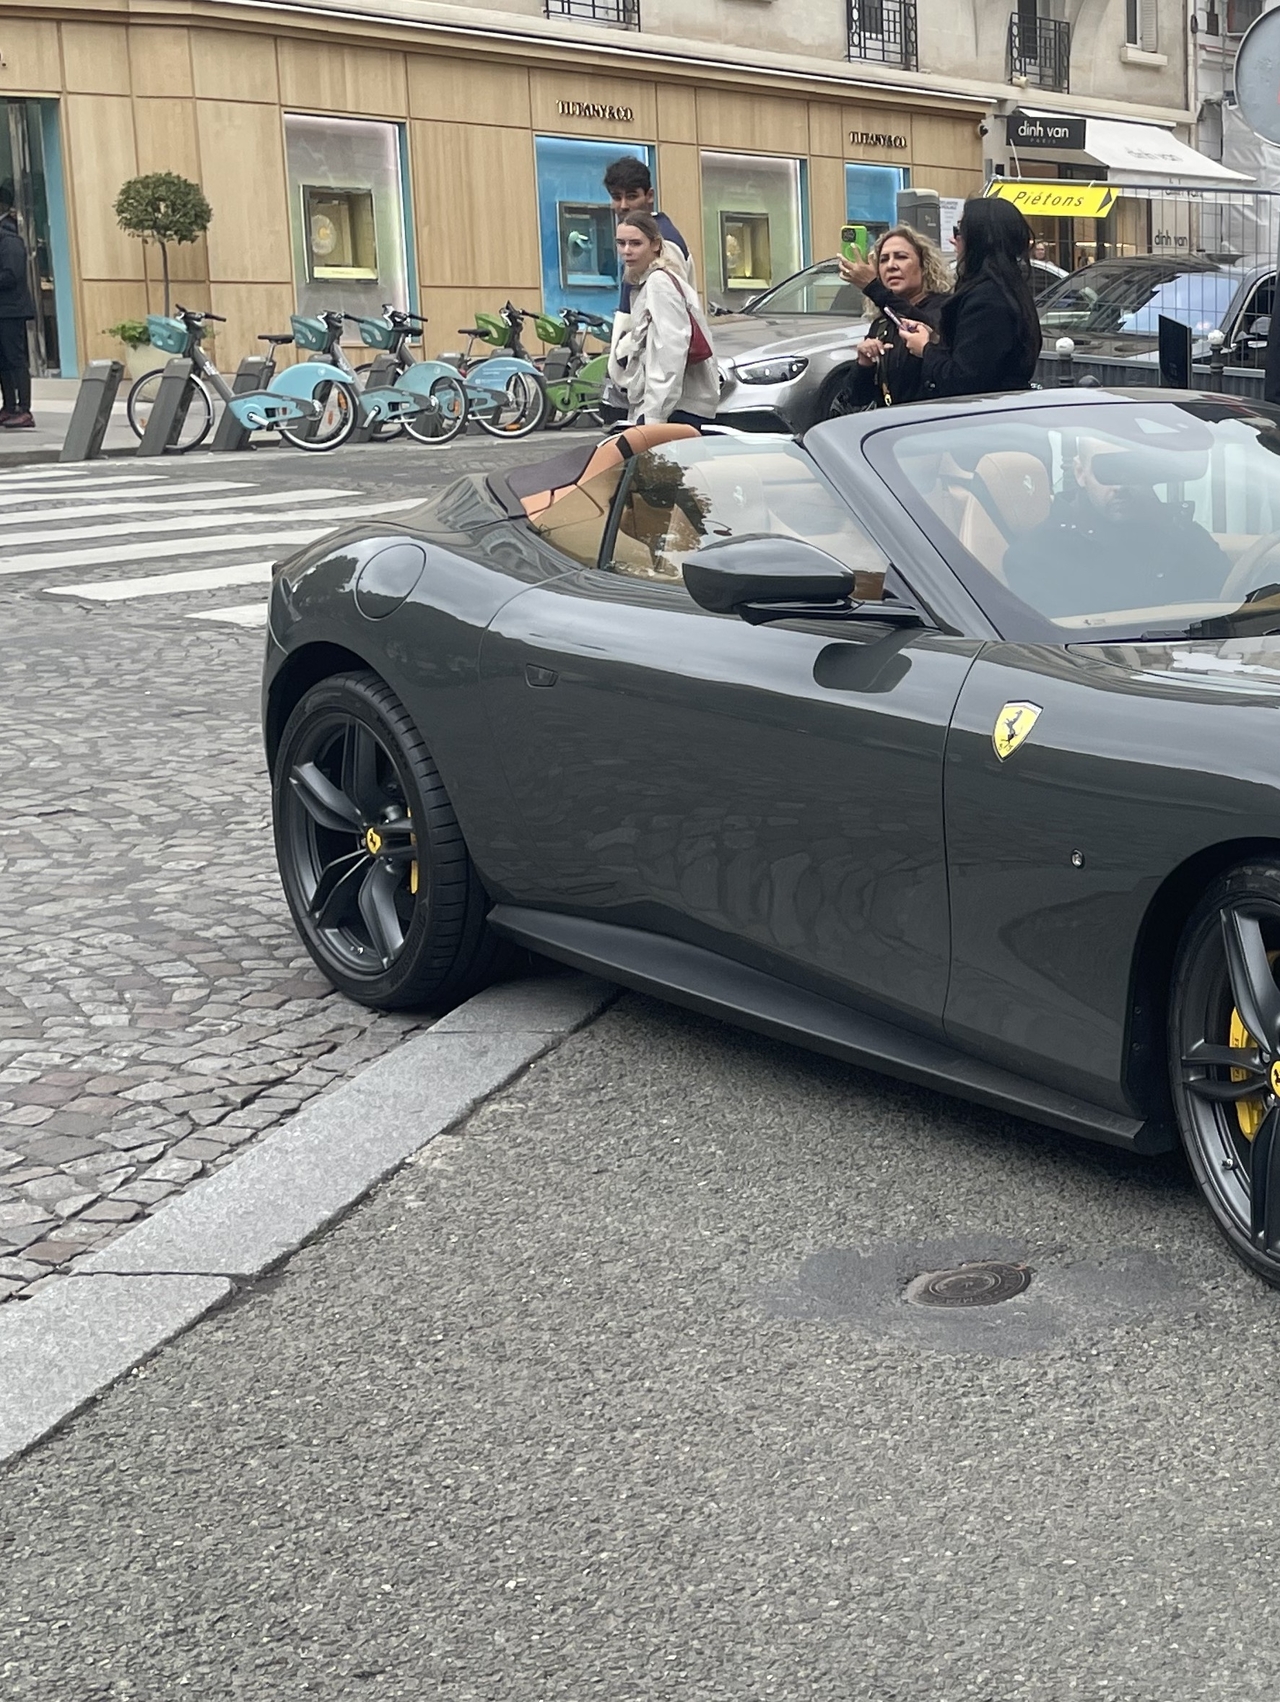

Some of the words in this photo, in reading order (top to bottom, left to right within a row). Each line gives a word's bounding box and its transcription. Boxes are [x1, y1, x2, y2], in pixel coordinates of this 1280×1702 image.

[1018, 120, 1044, 137] dinh
[1047, 126, 1069, 138] van
[1013, 190, 1085, 207] Piétons
[1154, 229, 1172, 246] dinh
[1173, 236, 1188, 247] van
